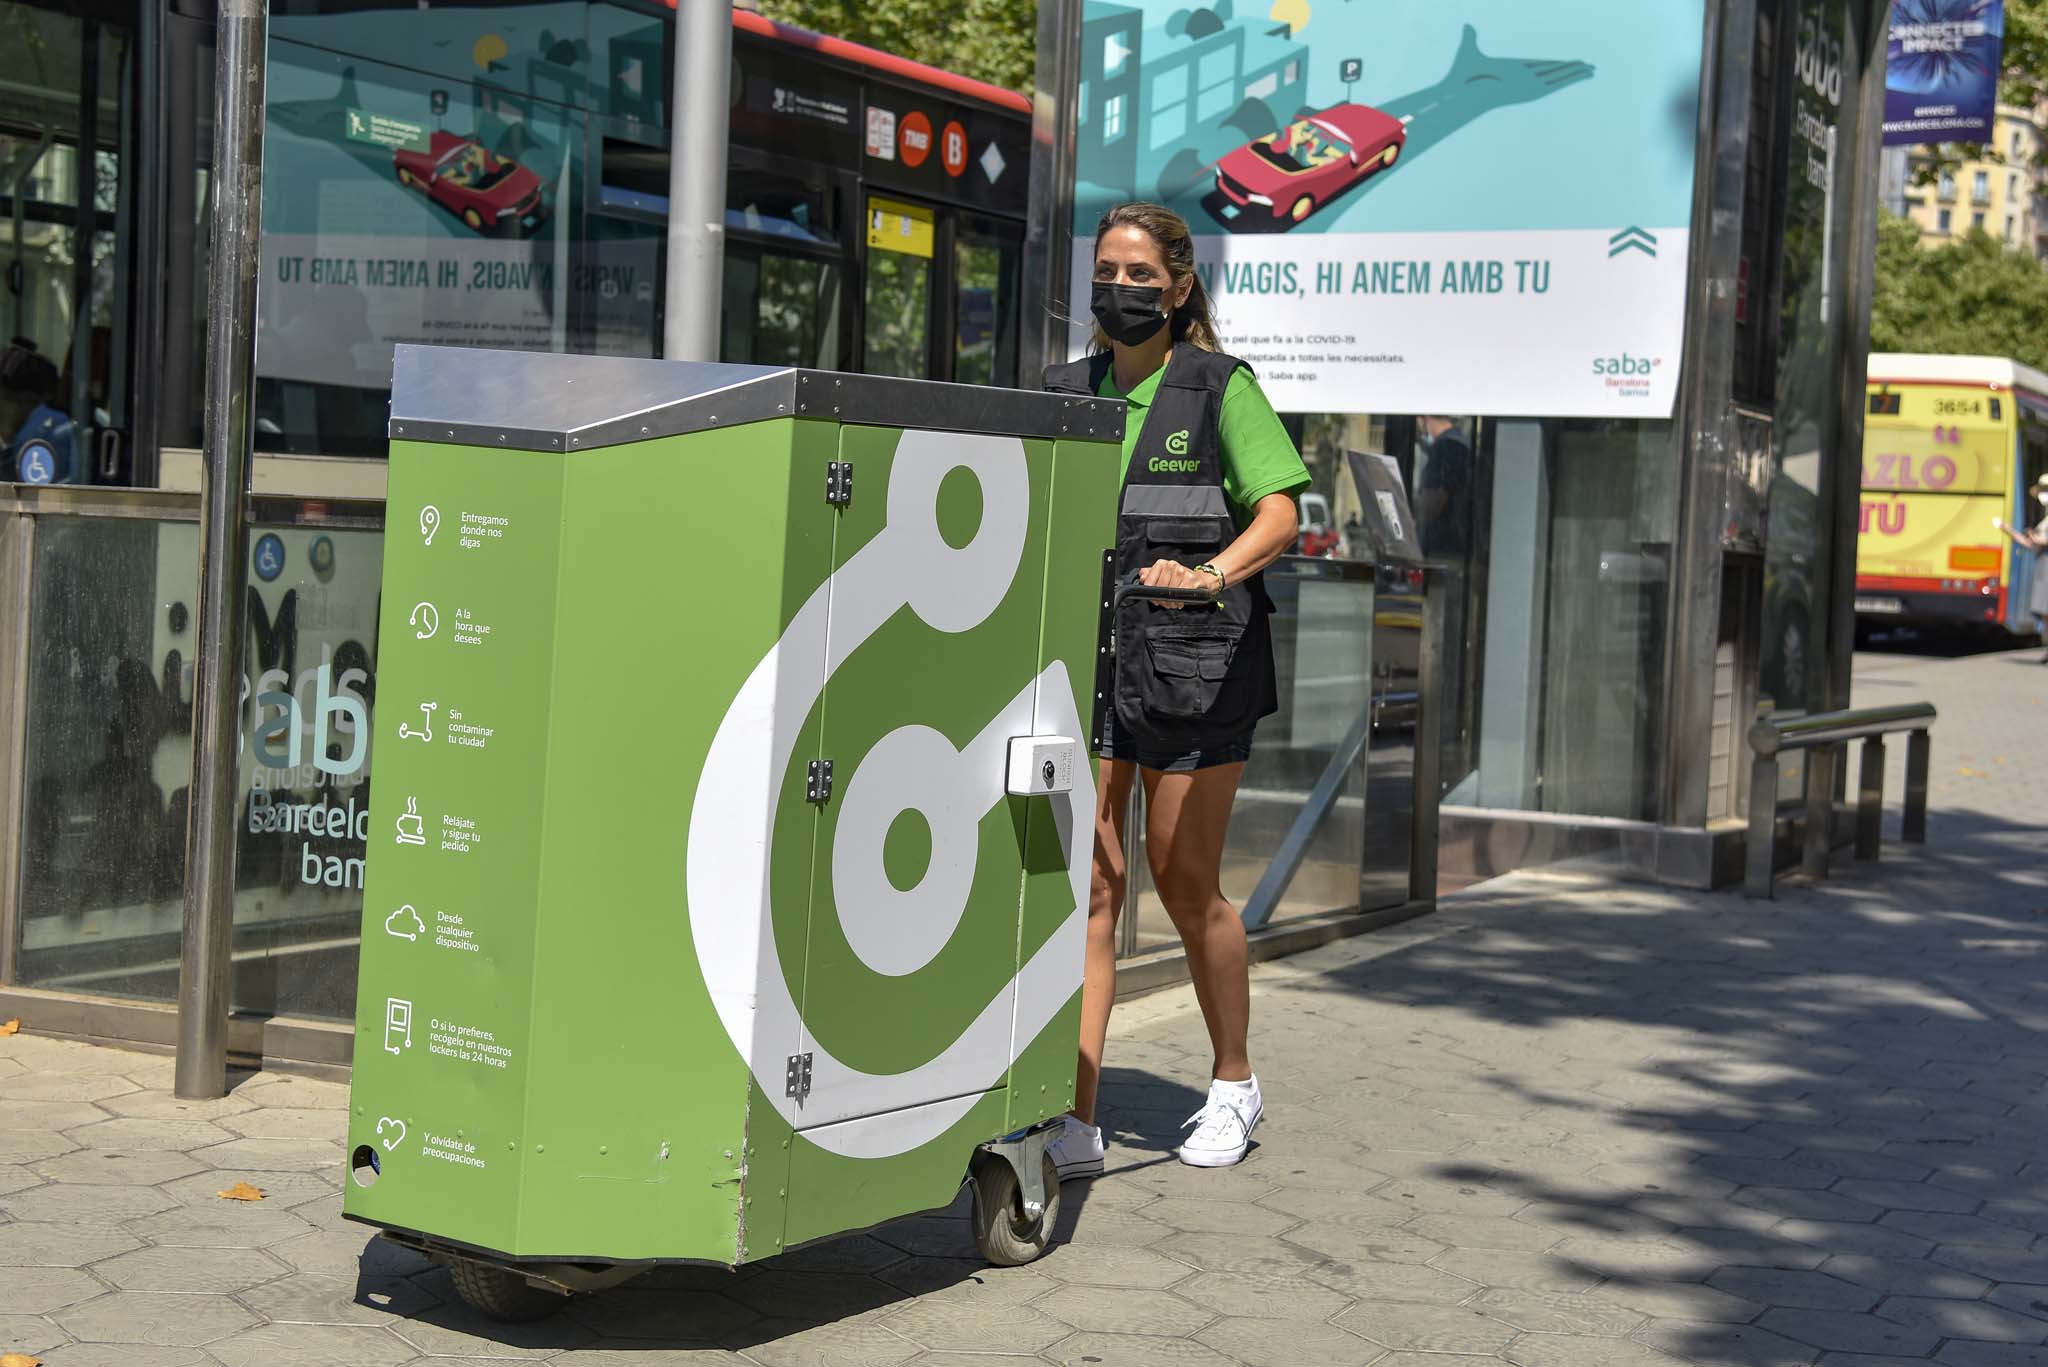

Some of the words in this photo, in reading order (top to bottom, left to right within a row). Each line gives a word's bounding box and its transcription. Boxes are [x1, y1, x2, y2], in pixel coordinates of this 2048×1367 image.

[1903, 38, 1962, 53] IMPACT
[905, 129, 929, 151] TMB
[948, 132, 962, 166] B
[1223, 261, 1306, 299] VAGIS,
[1316, 261, 1341, 294] HI
[1352, 261, 1431, 294] ANEM
[1440, 261, 1503, 293] AMB
[1513, 260, 1550, 293] TU
[1232, 335, 1248, 345] pel
[1251, 336, 1270, 345] que
[1273, 334, 1283, 343] fa
[1295, 335, 1303, 343] la
[1298, 354, 1324, 362] totes
[1327, 353, 1341, 362] les
[1593, 352, 1651, 375] saba
[1268, 371, 1293, 380] Saba
[1935, 399, 1980, 414] 3654
[1148, 457, 1200, 472] Geever
[461, 511, 509, 526] Entregamos
[460, 523, 486, 536] donde
[487, 529, 503, 537] nos
[459, 536, 481, 549] digas
[455, 608, 462, 618] A
[463, 608, 471, 619] la
[455, 619, 473, 632] hora
[474, 625, 490, 634] que
[454, 632, 482, 645] desees
[449, 708, 462, 720] Sin
[448, 723, 494, 737] contaminar
[448, 734, 457, 744] tu
[458, 735, 485, 748] ciudad
[443, 814, 475, 829] Relájate
[442, 829, 448, 838] y
[449, 828, 470, 841] sigue
[471, 832, 481, 842] tu
[441, 840, 470, 852] pedido
[437, 911, 463, 925] Desde
[436, 925, 474, 938] cualquier
[435, 935, 480, 952] dispositivo
[431, 1018, 439, 1029] O
[440, 1021, 447, 1031] si
[448, 1021, 456, 1033] lo
[457, 1026, 495, 1042] prefieres,
[430, 1032, 464, 1046] recógelo
[465, 1040, 476, 1049] en
[477, 1042, 512, 1057] nuestros
[429, 1041, 458, 1057] lockers
[459, 1049, 470, 1060] las
[471, 1051, 482, 1063] 24
[484, 1054, 507, 1068] horas
[424, 1131, 430, 1142] Y
[431, 1136, 463, 1151] olvídate
[464, 1142, 476, 1153] de
[422, 1146, 486, 1168] preocupaciones
